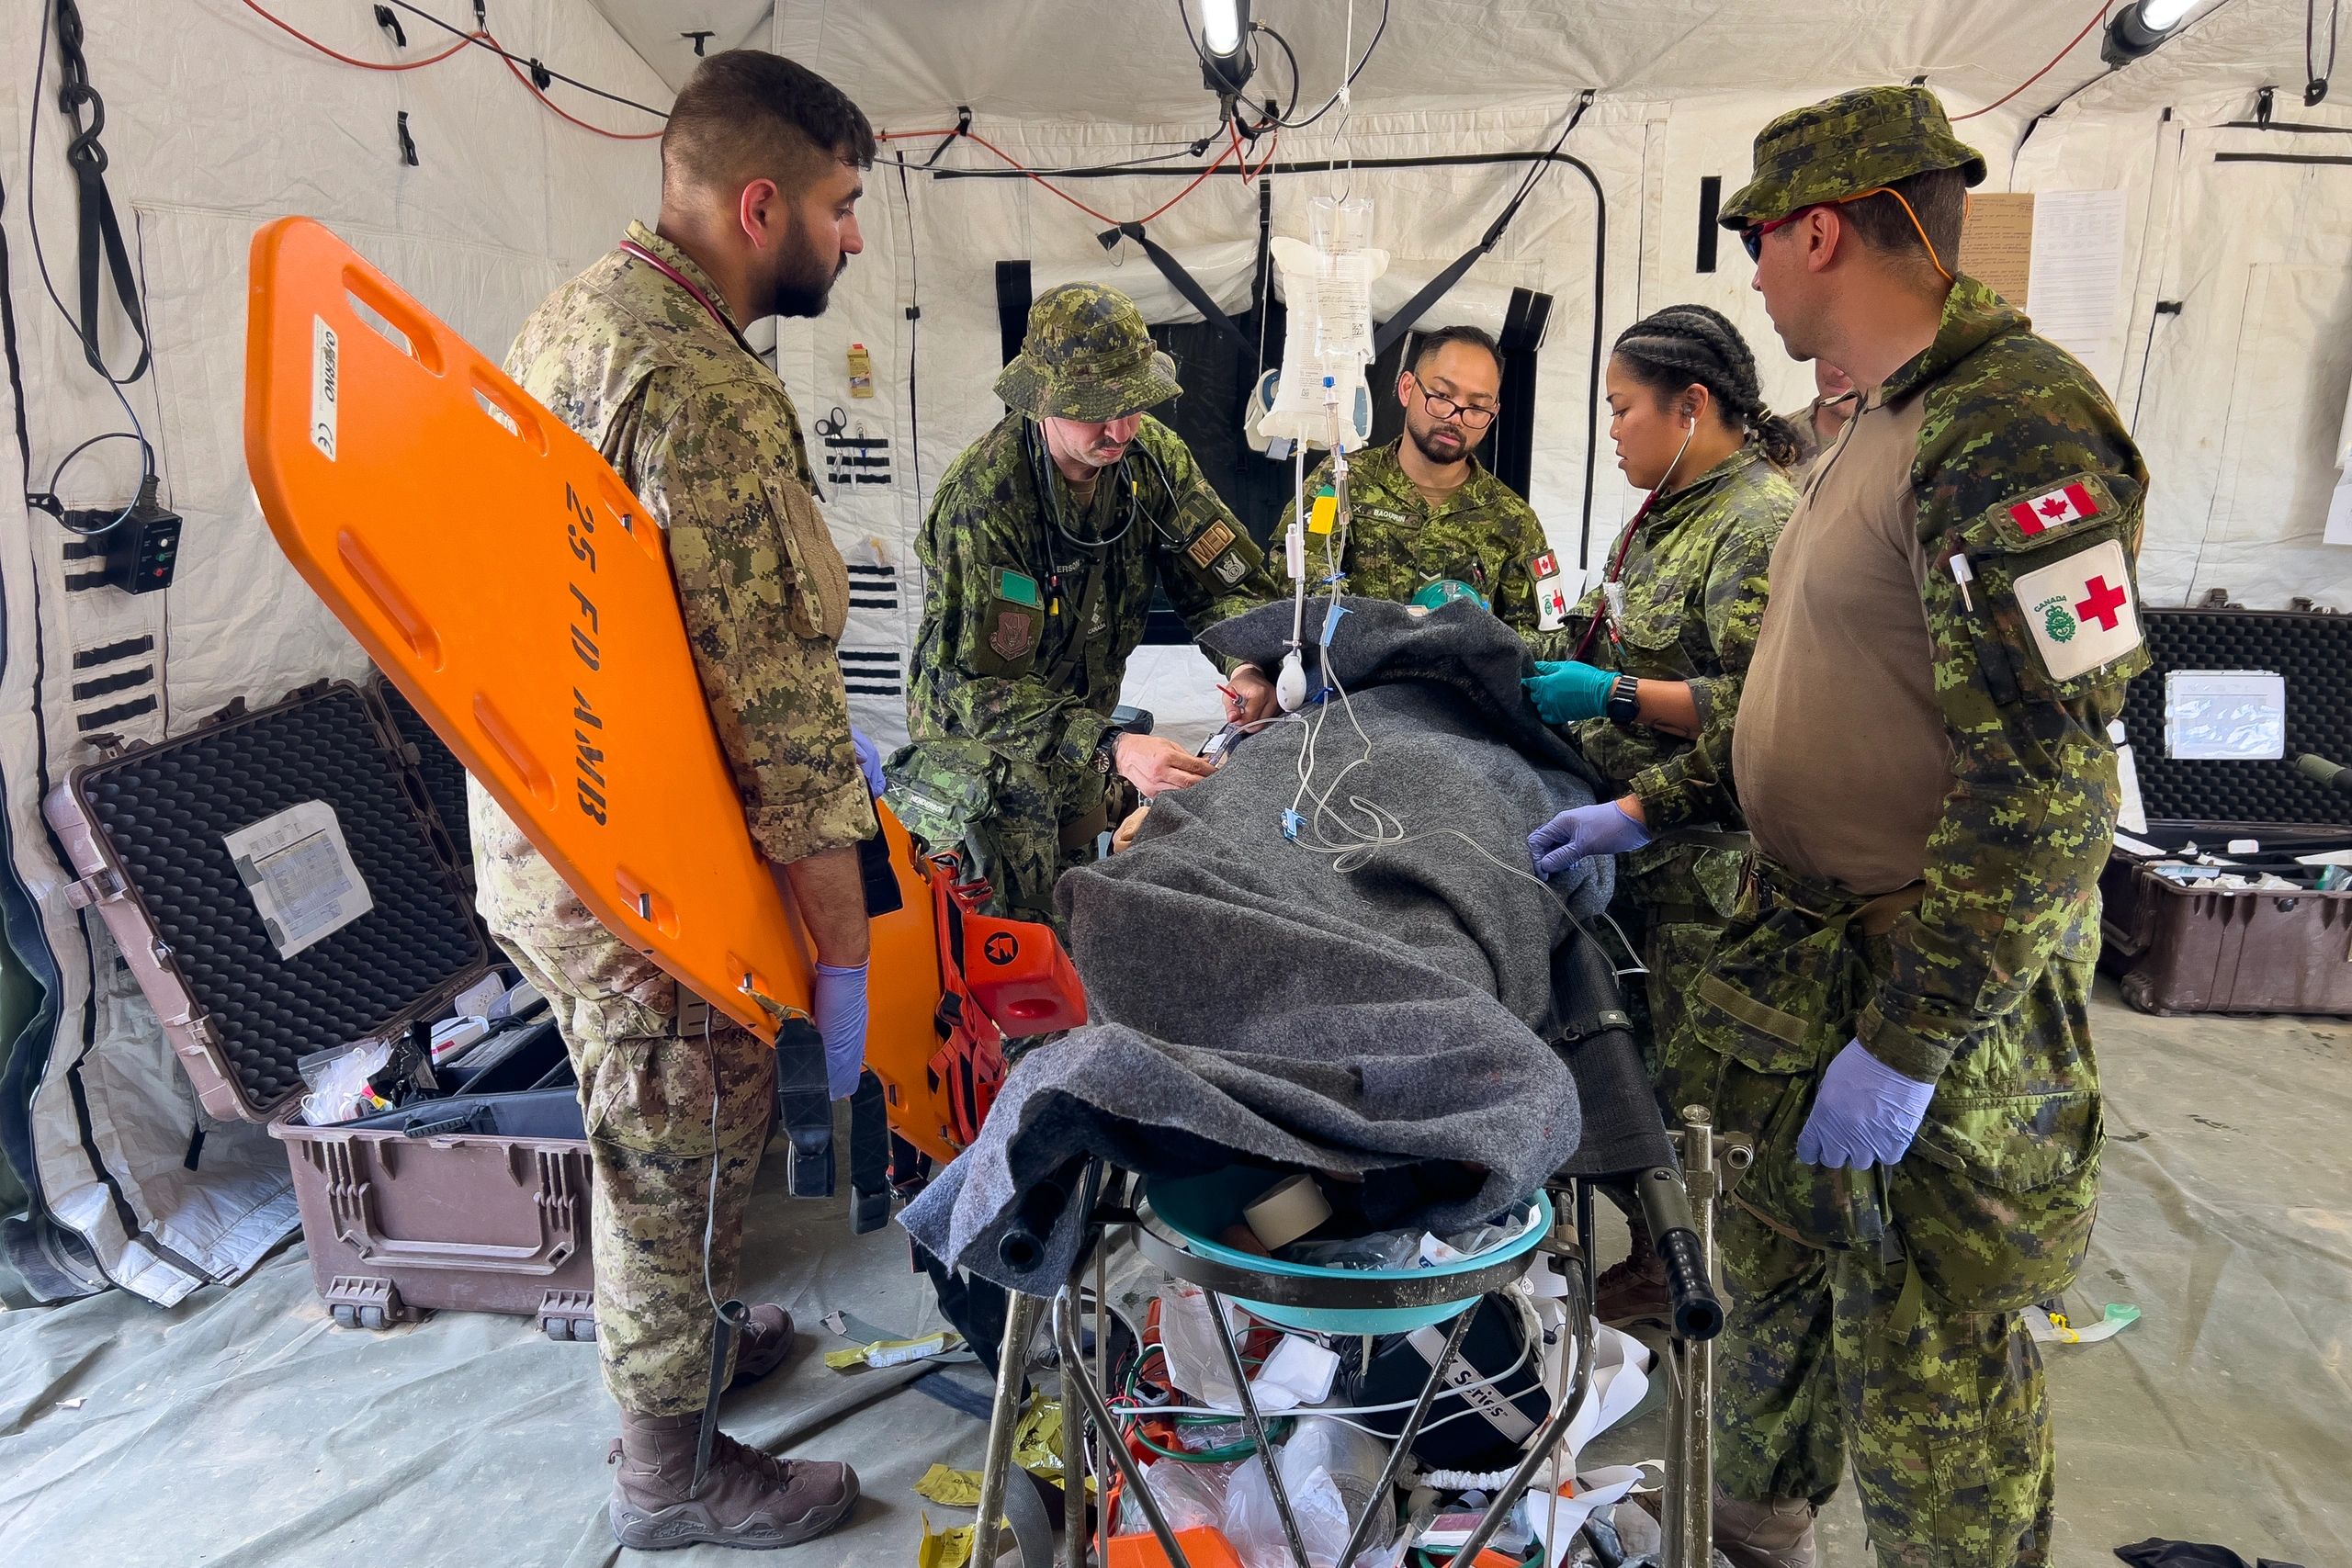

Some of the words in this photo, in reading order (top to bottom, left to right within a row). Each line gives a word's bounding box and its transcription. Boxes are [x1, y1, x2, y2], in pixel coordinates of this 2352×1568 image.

[565, 480, 596, 574] 25
[1190, 525, 1230, 566] MED
[569, 581, 599, 671] FD
[2033, 594, 2067, 613] CANADA
[572, 685, 607, 827] AMB
